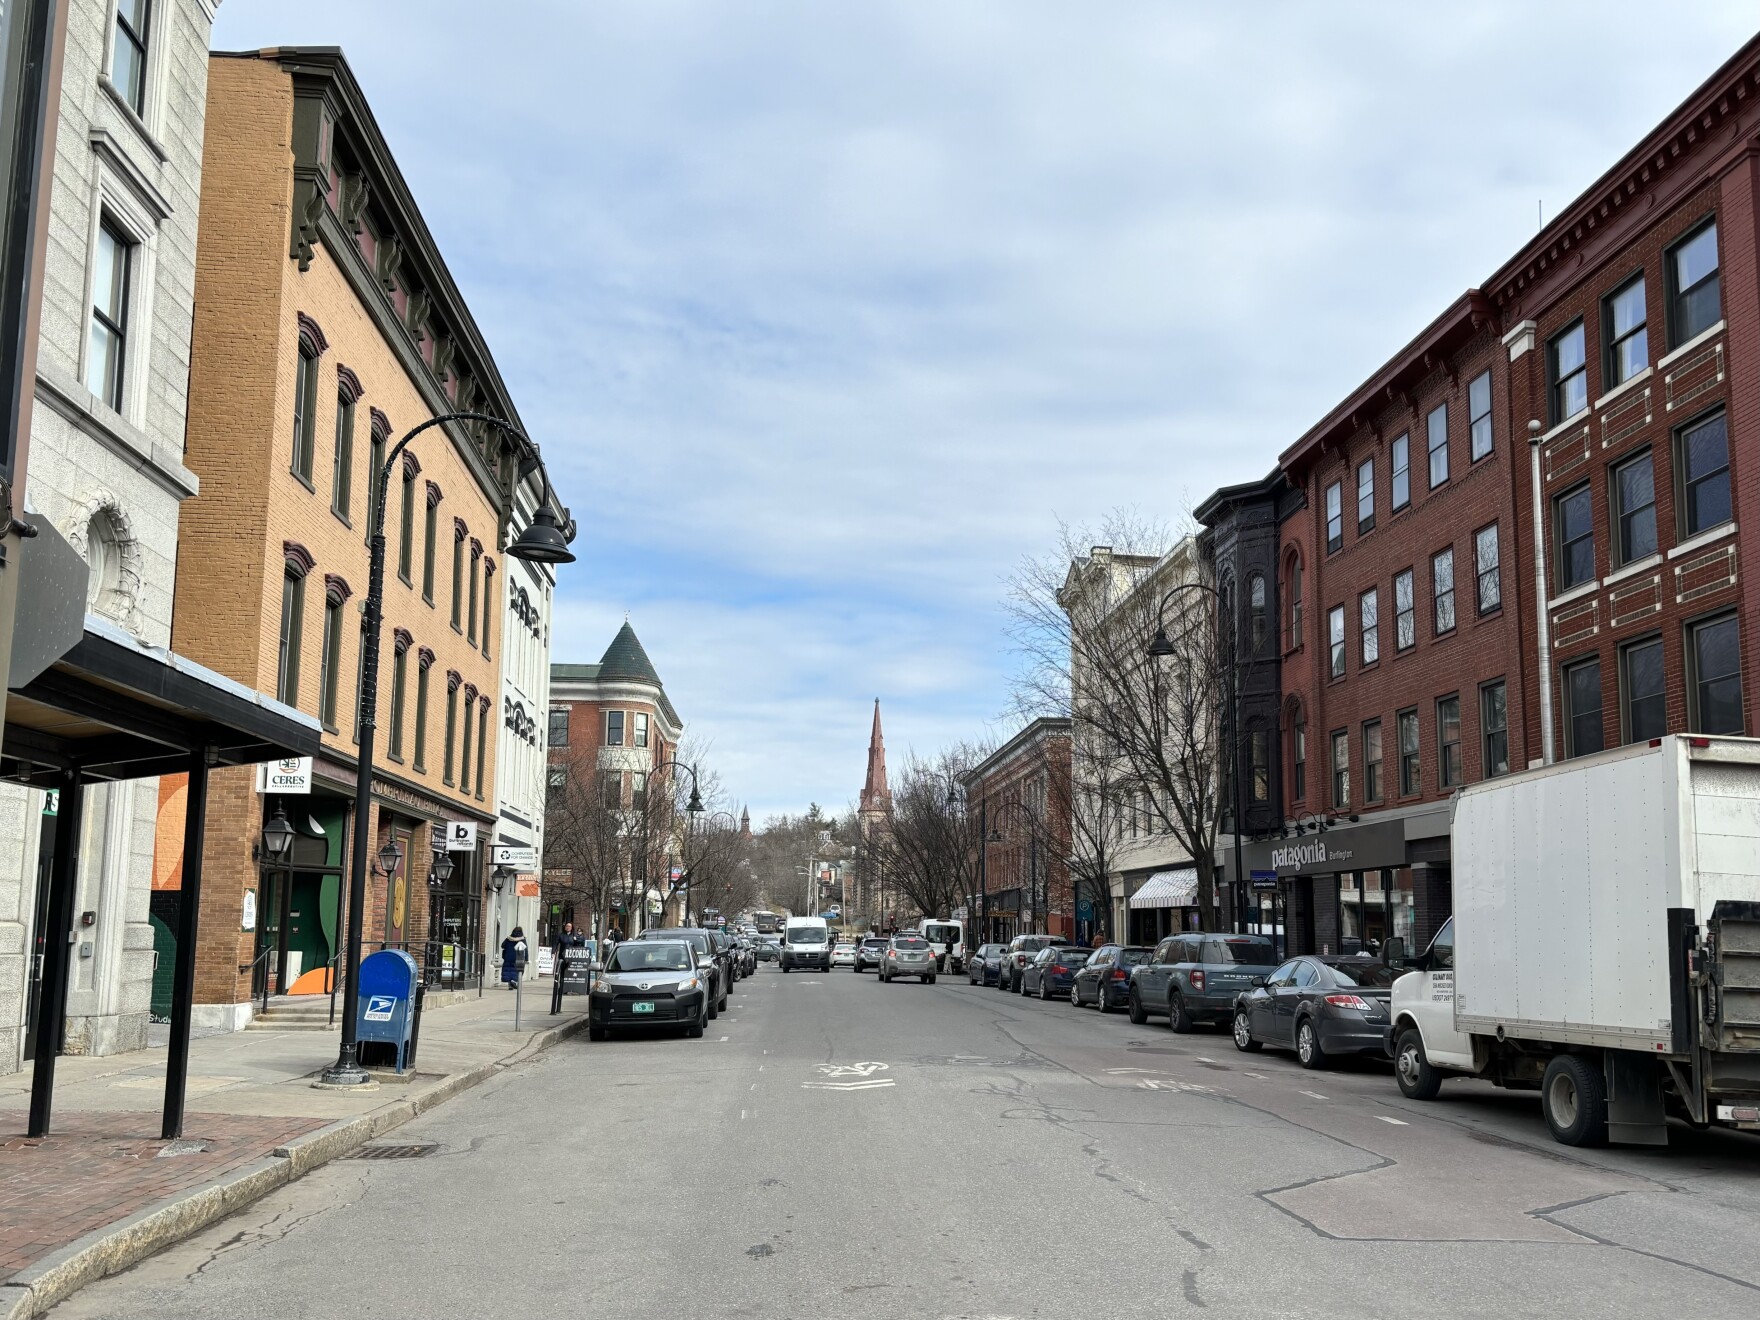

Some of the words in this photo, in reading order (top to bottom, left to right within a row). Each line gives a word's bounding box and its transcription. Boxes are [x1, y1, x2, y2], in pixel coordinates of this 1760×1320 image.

[272, 775, 305, 785] CERES
[1272, 838, 1327, 871] patagonia
[1330, 850, 1353, 860] Burlington
[564, 948, 590, 959] RECORDS
